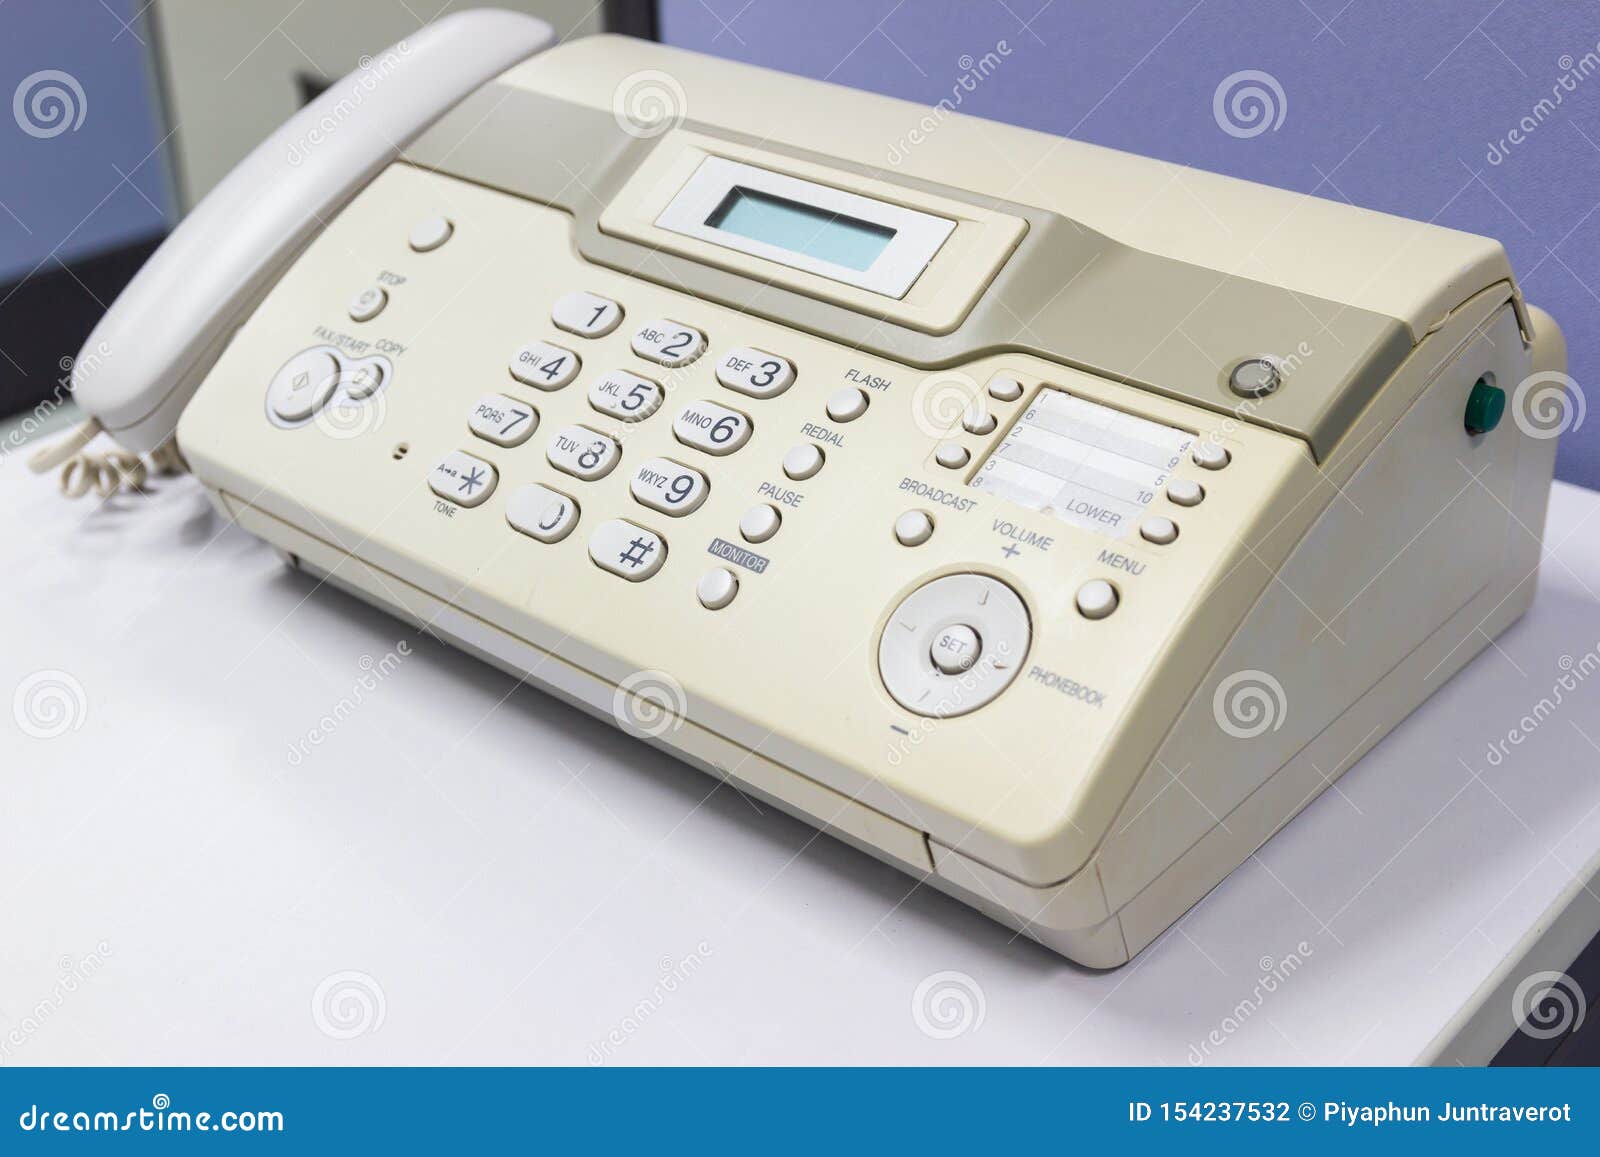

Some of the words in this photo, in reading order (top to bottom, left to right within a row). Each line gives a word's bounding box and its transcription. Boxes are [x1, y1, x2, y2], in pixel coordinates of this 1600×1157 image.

[377, 270, 406, 285] STOP
[587, 305, 607, 327] 1
[313, 326, 369, 353] FAX/START
[376, 338, 407, 356] COPY
[638, 328, 665, 344] ABC
[661, 332, 693, 358] 2
[519, 351, 541, 368] GHI
[540, 357, 567, 380] 4
[726, 357, 752, 373] DEF
[750, 361, 781, 387] 3
[844, 368, 892, 392] FLASH
[598, 381, 620, 397] JKL
[621, 384, 652, 410] 5
[476, 404, 505, 424] PQRS
[500, 409, 529, 435] 7
[681, 409, 712, 429] MNO
[709, 416, 740, 444] 6
[1025, 409, 1037, 421] 6
[800, 423, 845, 448] REDIAL
[1011, 426, 1024, 438] 2
[556, 436, 580, 453] TUV
[578, 441, 607, 469] 8
[1000, 443, 1012, 455] 7
[985, 460, 996, 471] 3
[637, 467, 668, 489] WXYZ
[664, 474, 694, 504] 9
[972, 476, 984, 488] 8
[1154, 475, 1167, 486] 5
[757, 481, 805, 508] PAUSE
[898, 477, 978, 513] BROADCAST
[1136, 490, 1154, 504] 10
[433, 500, 457, 518] TONE
[1065, 498, 1122, 526] LOWER
[991, 519, 1055, 551] VOLUME
[619, 537, 654, 568] #
[711, 540, 768, 574] MONITOR
[1097, 550, 1146, 576] MENU
[939, 635, 967, 655] SET
[1027, 665, 1107, 709] PHONEBOOK
